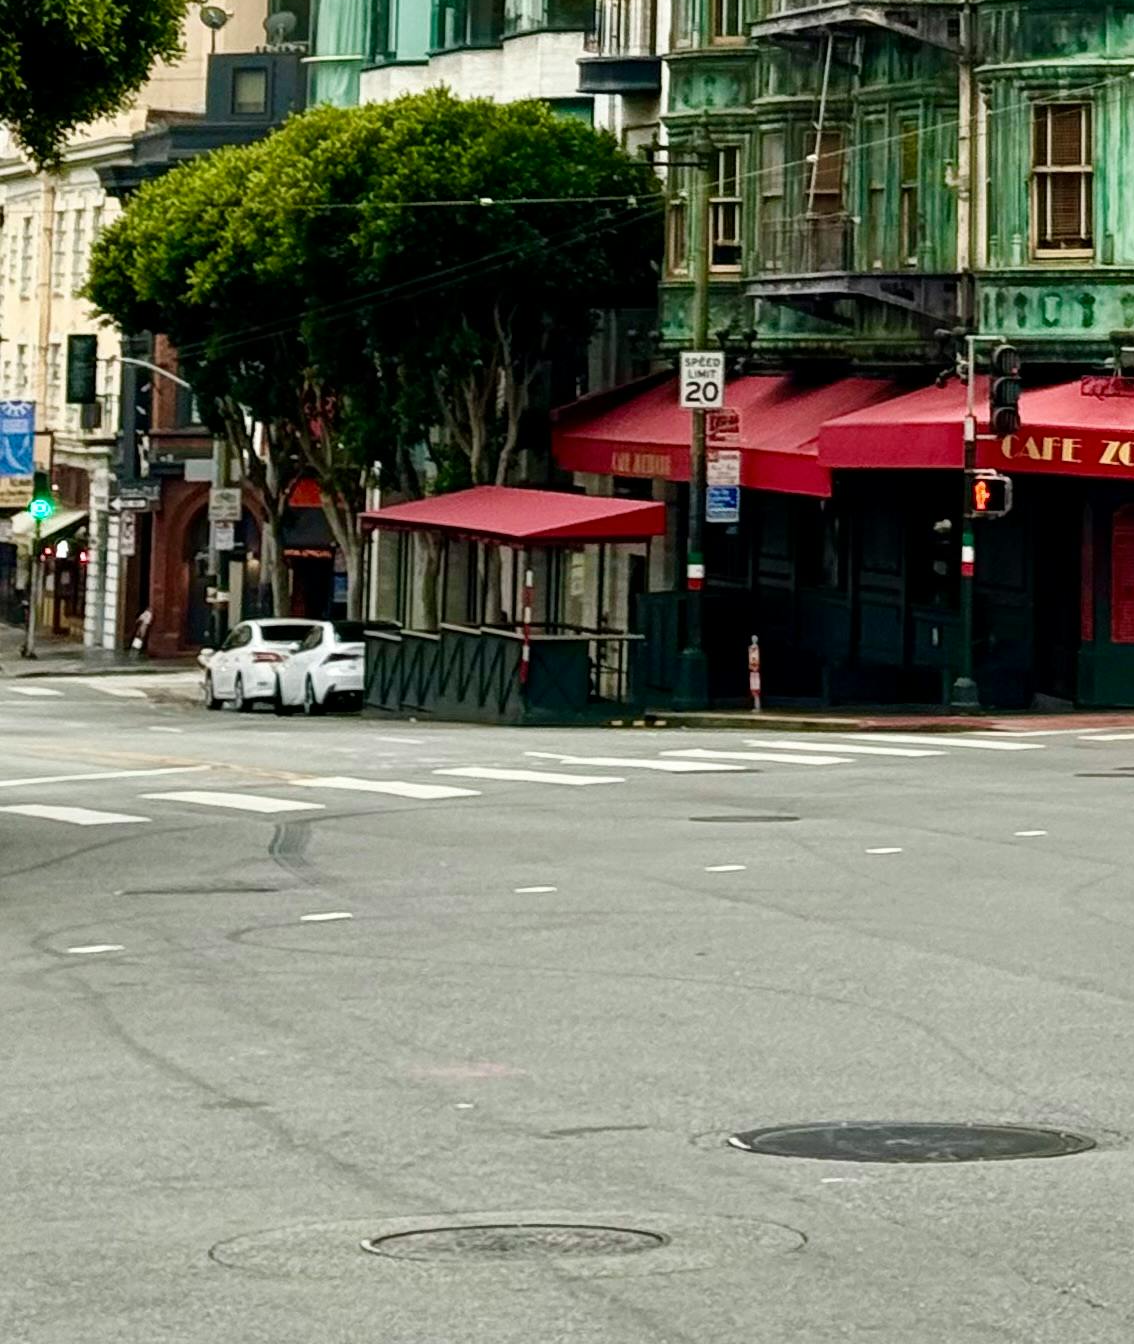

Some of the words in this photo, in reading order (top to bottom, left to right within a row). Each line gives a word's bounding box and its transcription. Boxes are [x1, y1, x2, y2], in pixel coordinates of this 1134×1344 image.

[684, 357, 720, 367] SPEED
[687, 369, 717, 379] LIMIT
[684, 381, 720, 402] 20
[1001, 434, 1082, 463] CAFE
